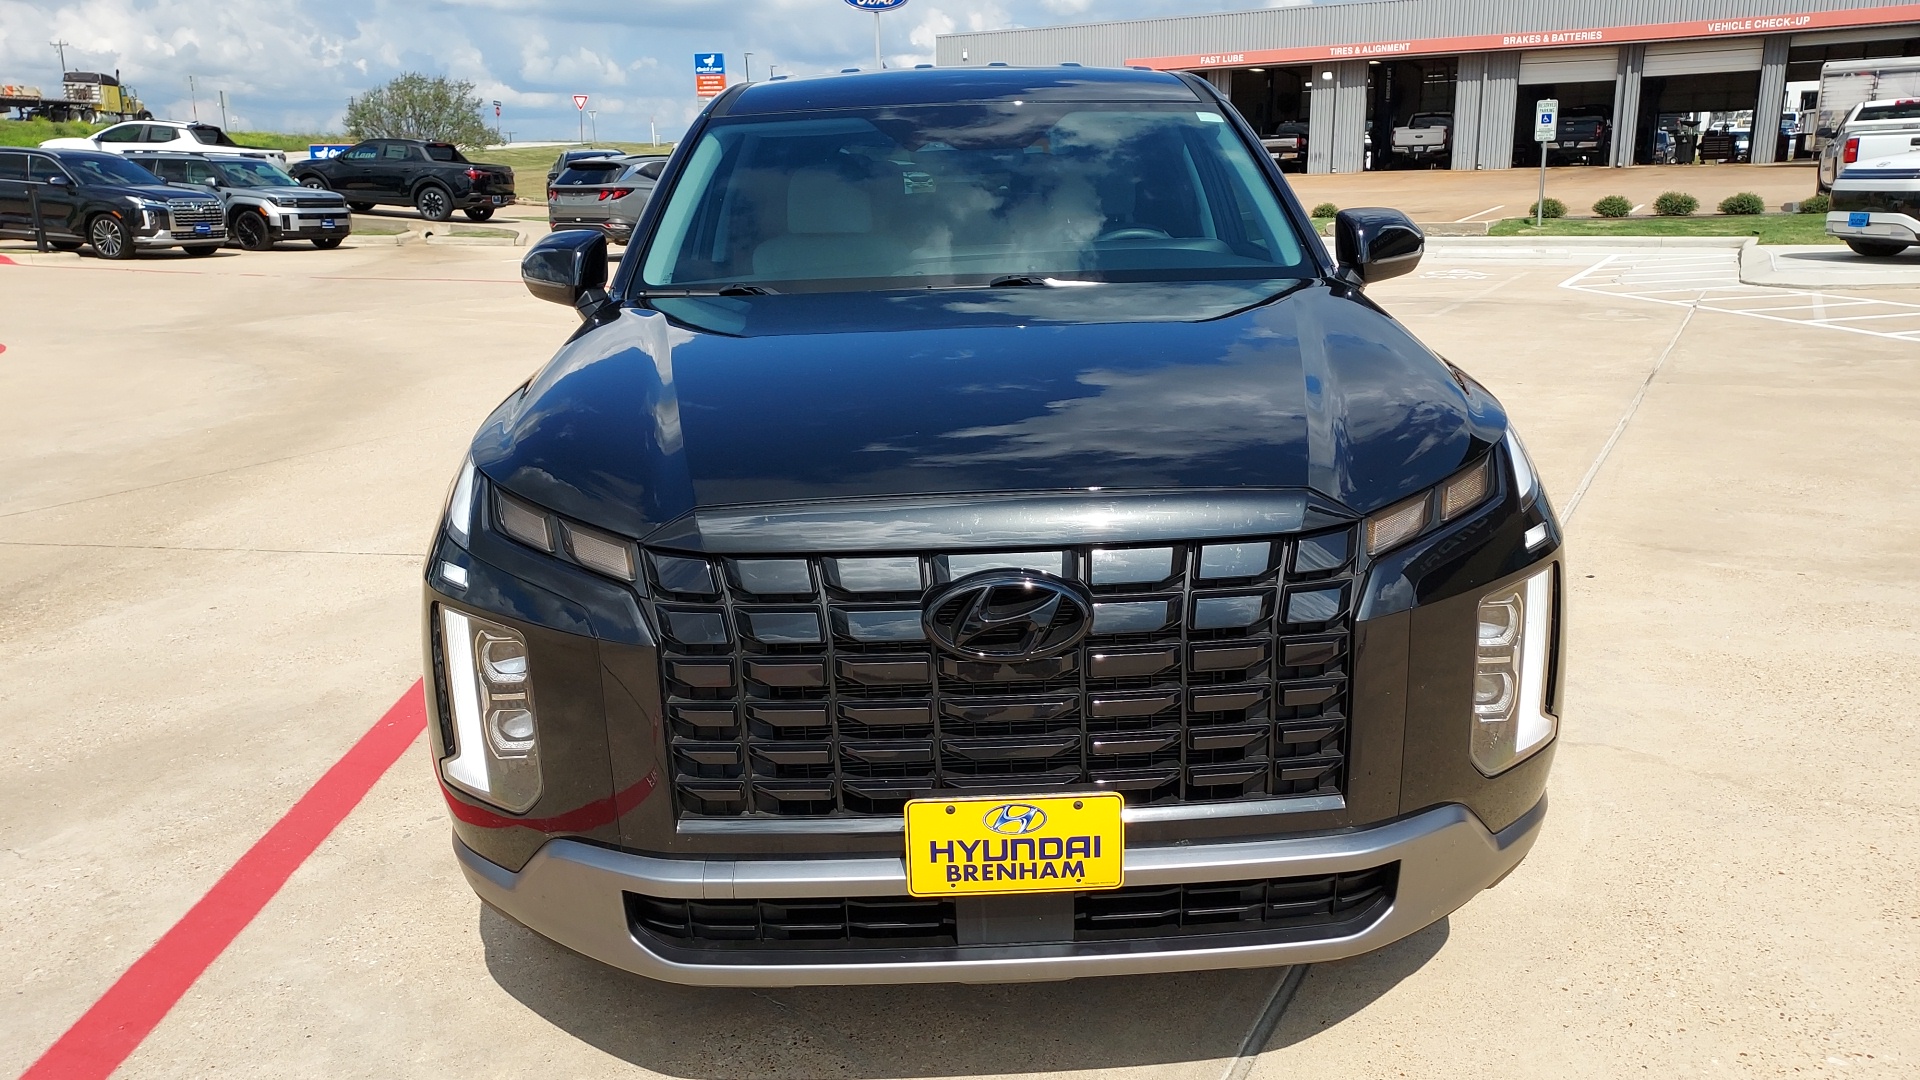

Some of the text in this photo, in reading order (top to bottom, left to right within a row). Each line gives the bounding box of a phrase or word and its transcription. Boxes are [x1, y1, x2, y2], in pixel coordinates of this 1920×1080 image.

[1707, 16, 1811, 32] VEHICLE CHECK-UP
[1503, 31, 1603, 45] BRAKES & BATTERIES
[1330, 42, 1411, 56] TIRES & ALIGNMENT
[1200, 54, 1245, 65] FAST LUBE
[354, 151, 376, 159] Lane
[929, 835, 1101, 864] HYUNDAI
[946, 860, 1086, 883] BRENHAM
